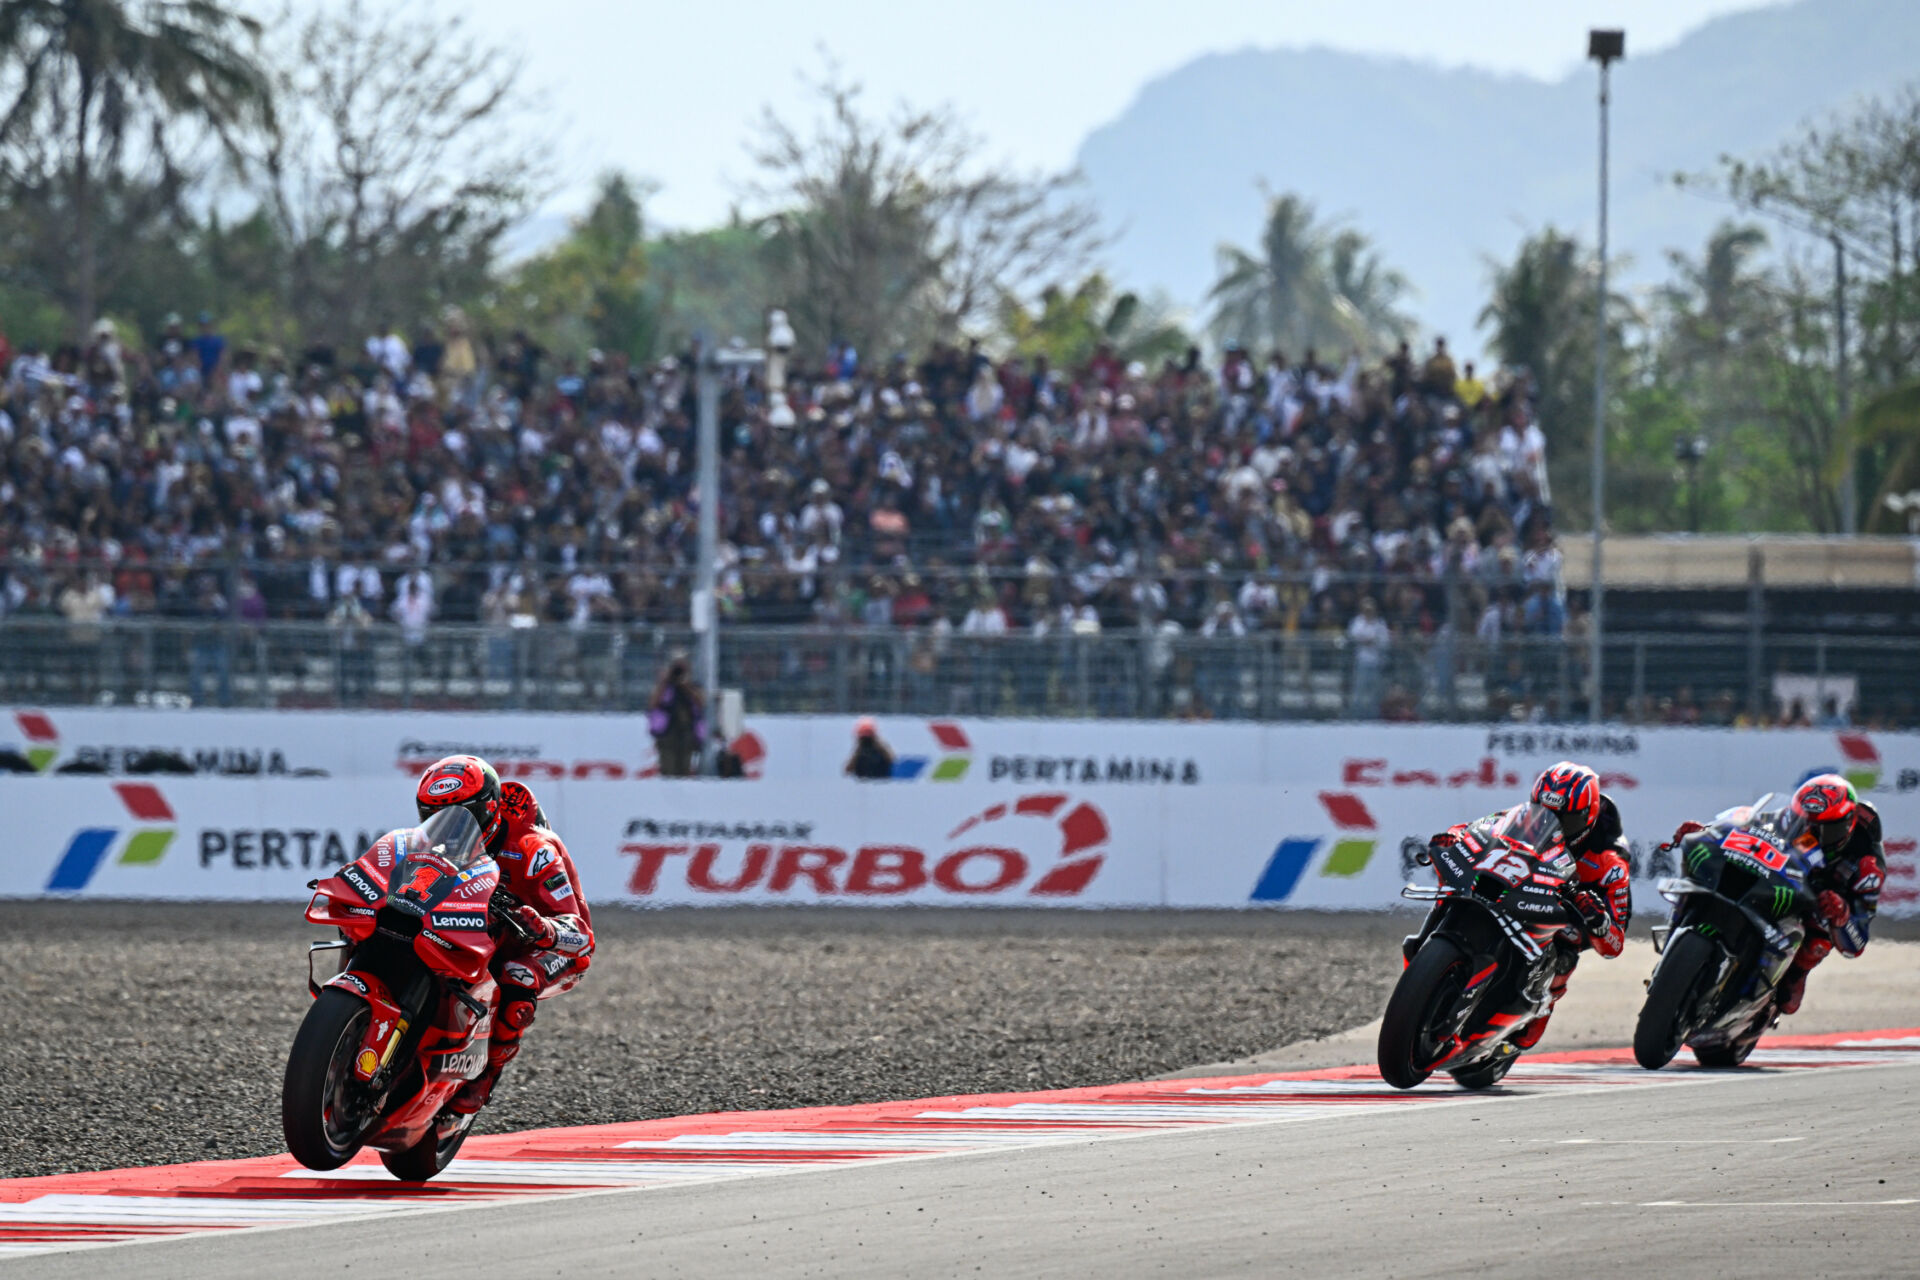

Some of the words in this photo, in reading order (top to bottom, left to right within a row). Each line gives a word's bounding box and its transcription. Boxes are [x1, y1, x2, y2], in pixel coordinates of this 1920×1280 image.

[990, 757, 1198, 784] PERTAMINA
[623, 818, 812, 840] PERTAMAX
[619, 845, 1030, 895] TURBO
[1440, 851, 1464, 878] CAREAR
[1473, 848, 1531, 887] 12
[343, 866, 379, 901] Lenovo
[395, 863, 444, 904] 1
[1516, 901, 1554, 914] CAREAR
[431, 915, 485, 928] Lenovo
[422, 929, 453, 950] CARRERA
[440, 1053, 485, 1074] Lenovo
